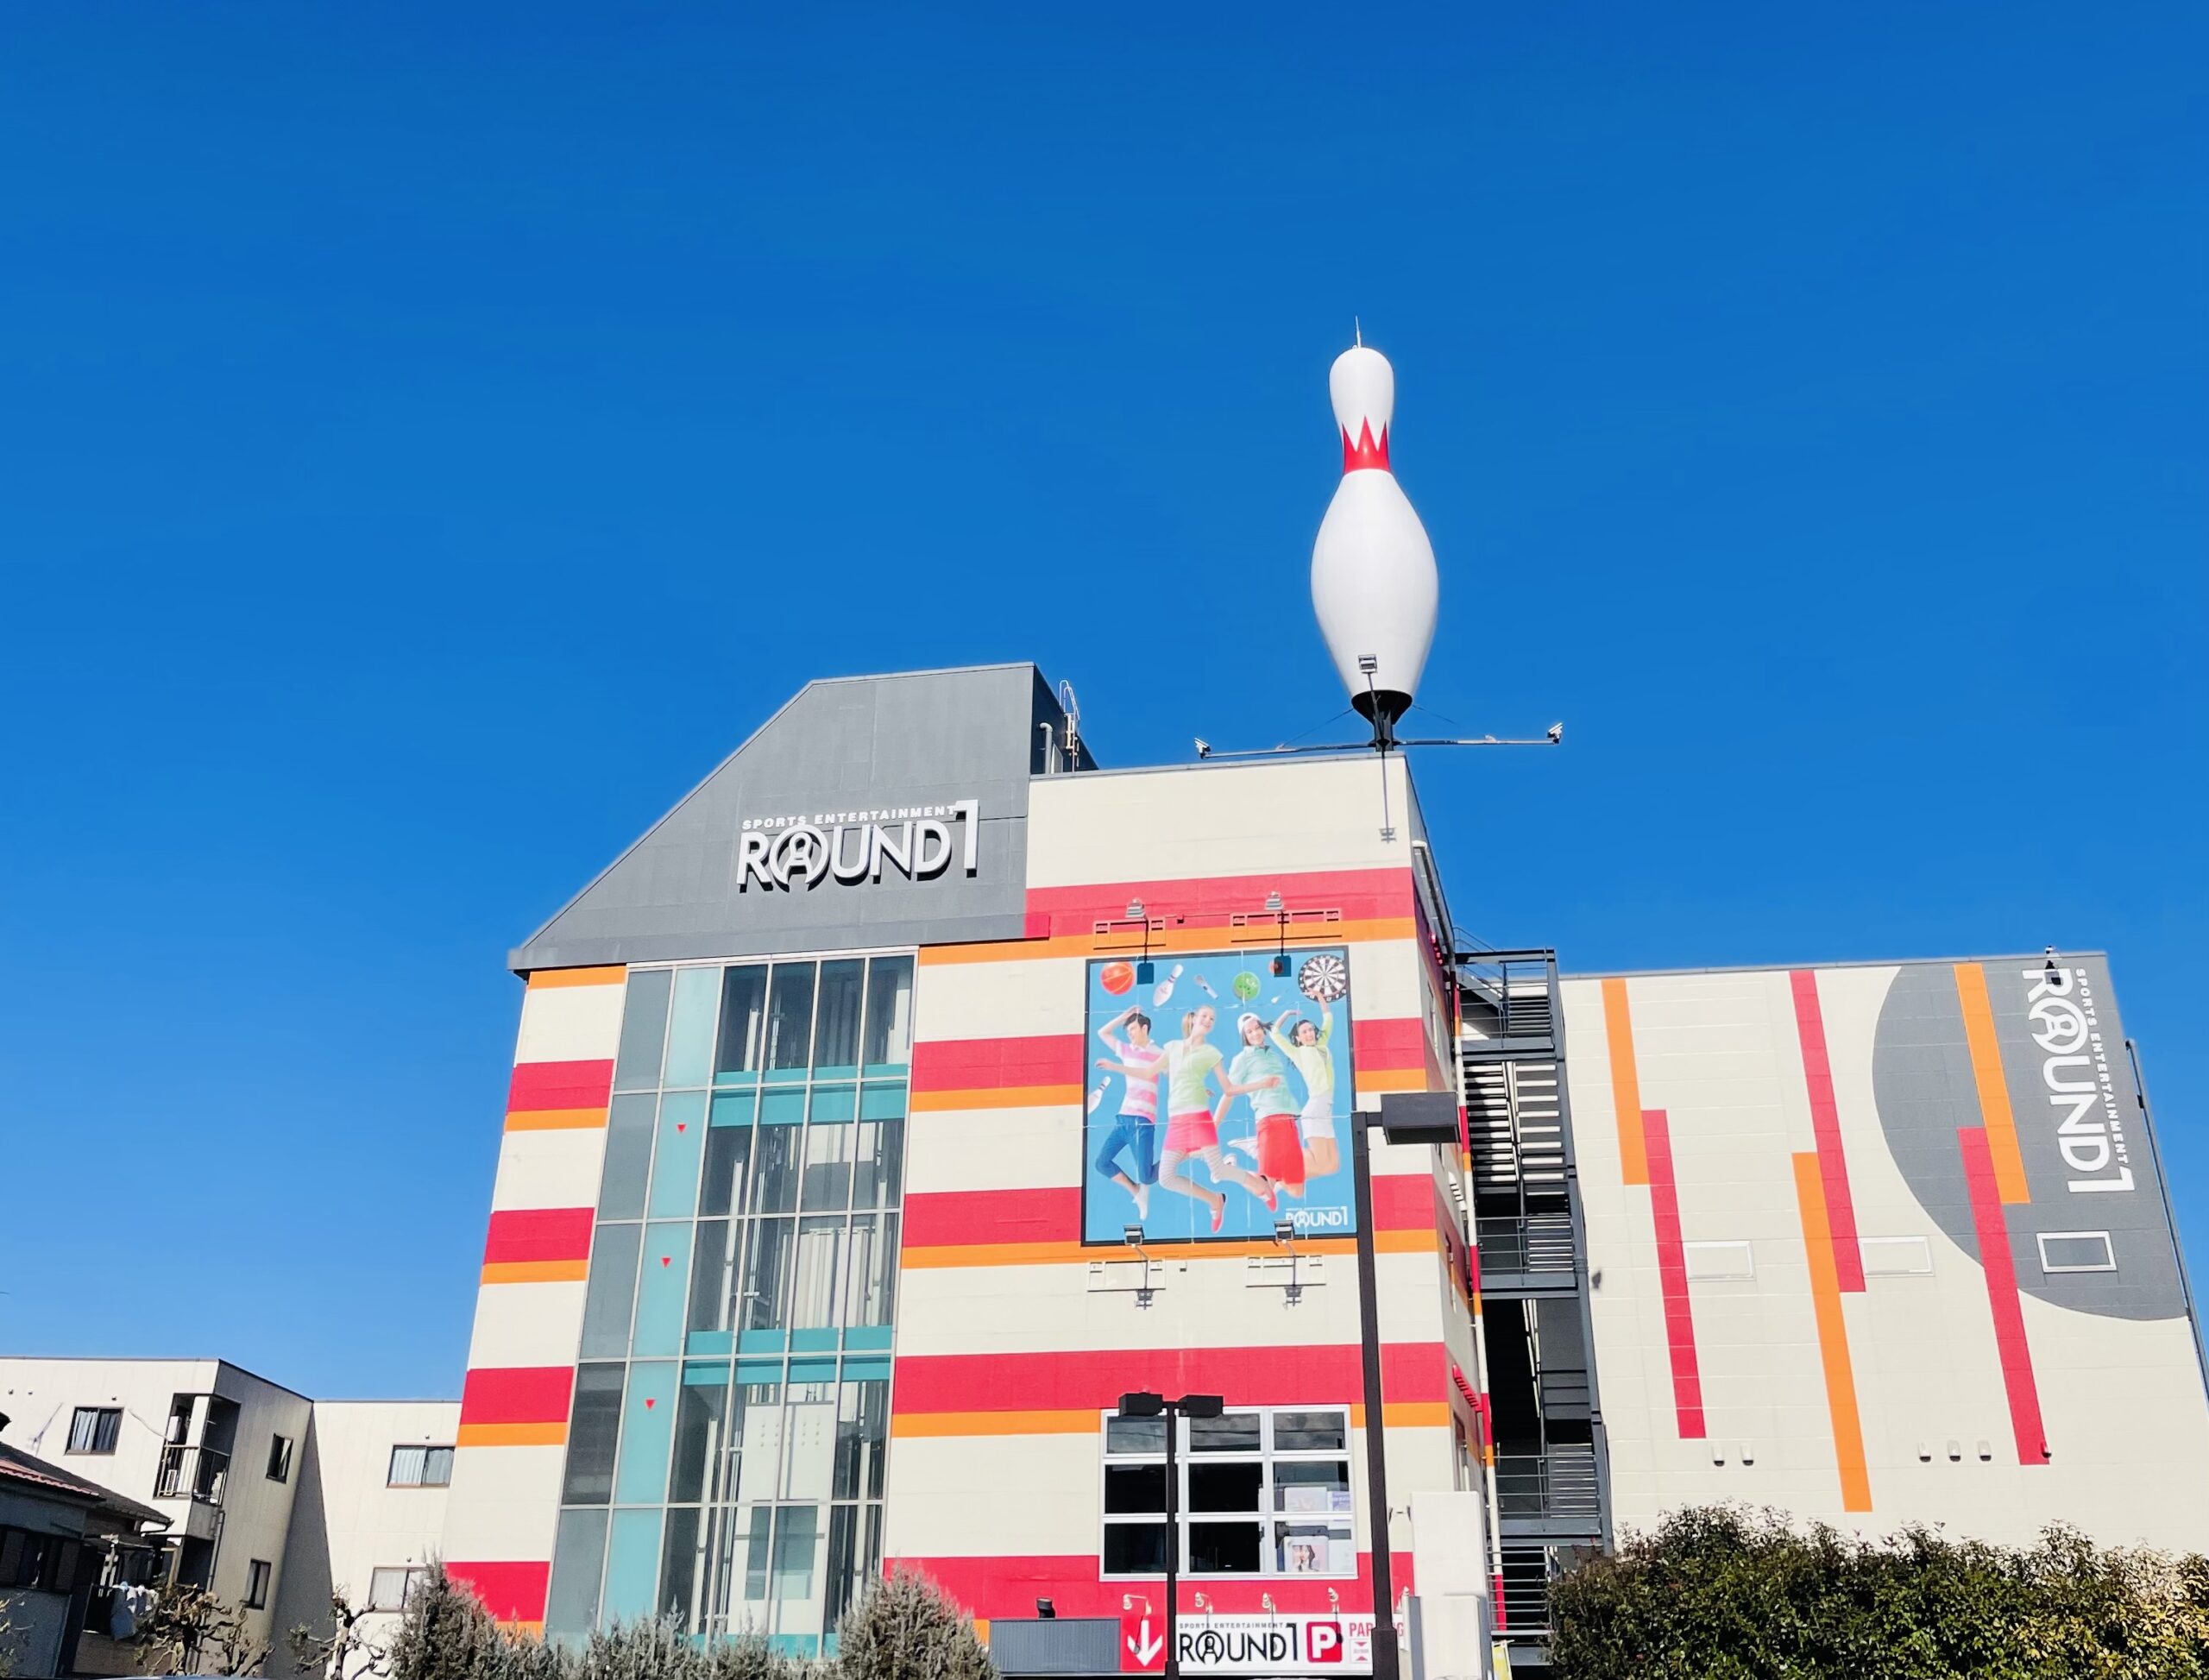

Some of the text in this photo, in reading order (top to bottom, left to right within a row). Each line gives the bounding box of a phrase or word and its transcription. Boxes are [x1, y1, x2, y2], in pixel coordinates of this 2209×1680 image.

[742, 805, 957, 830] SPORTS ENTERTAINMENT
[2075, 967, 2129, 1165] SPORTS ENTERTAINMENT
[1312, 1626, 1337, 1658] P
[1349, 1622, 1404, 1638] PARG
